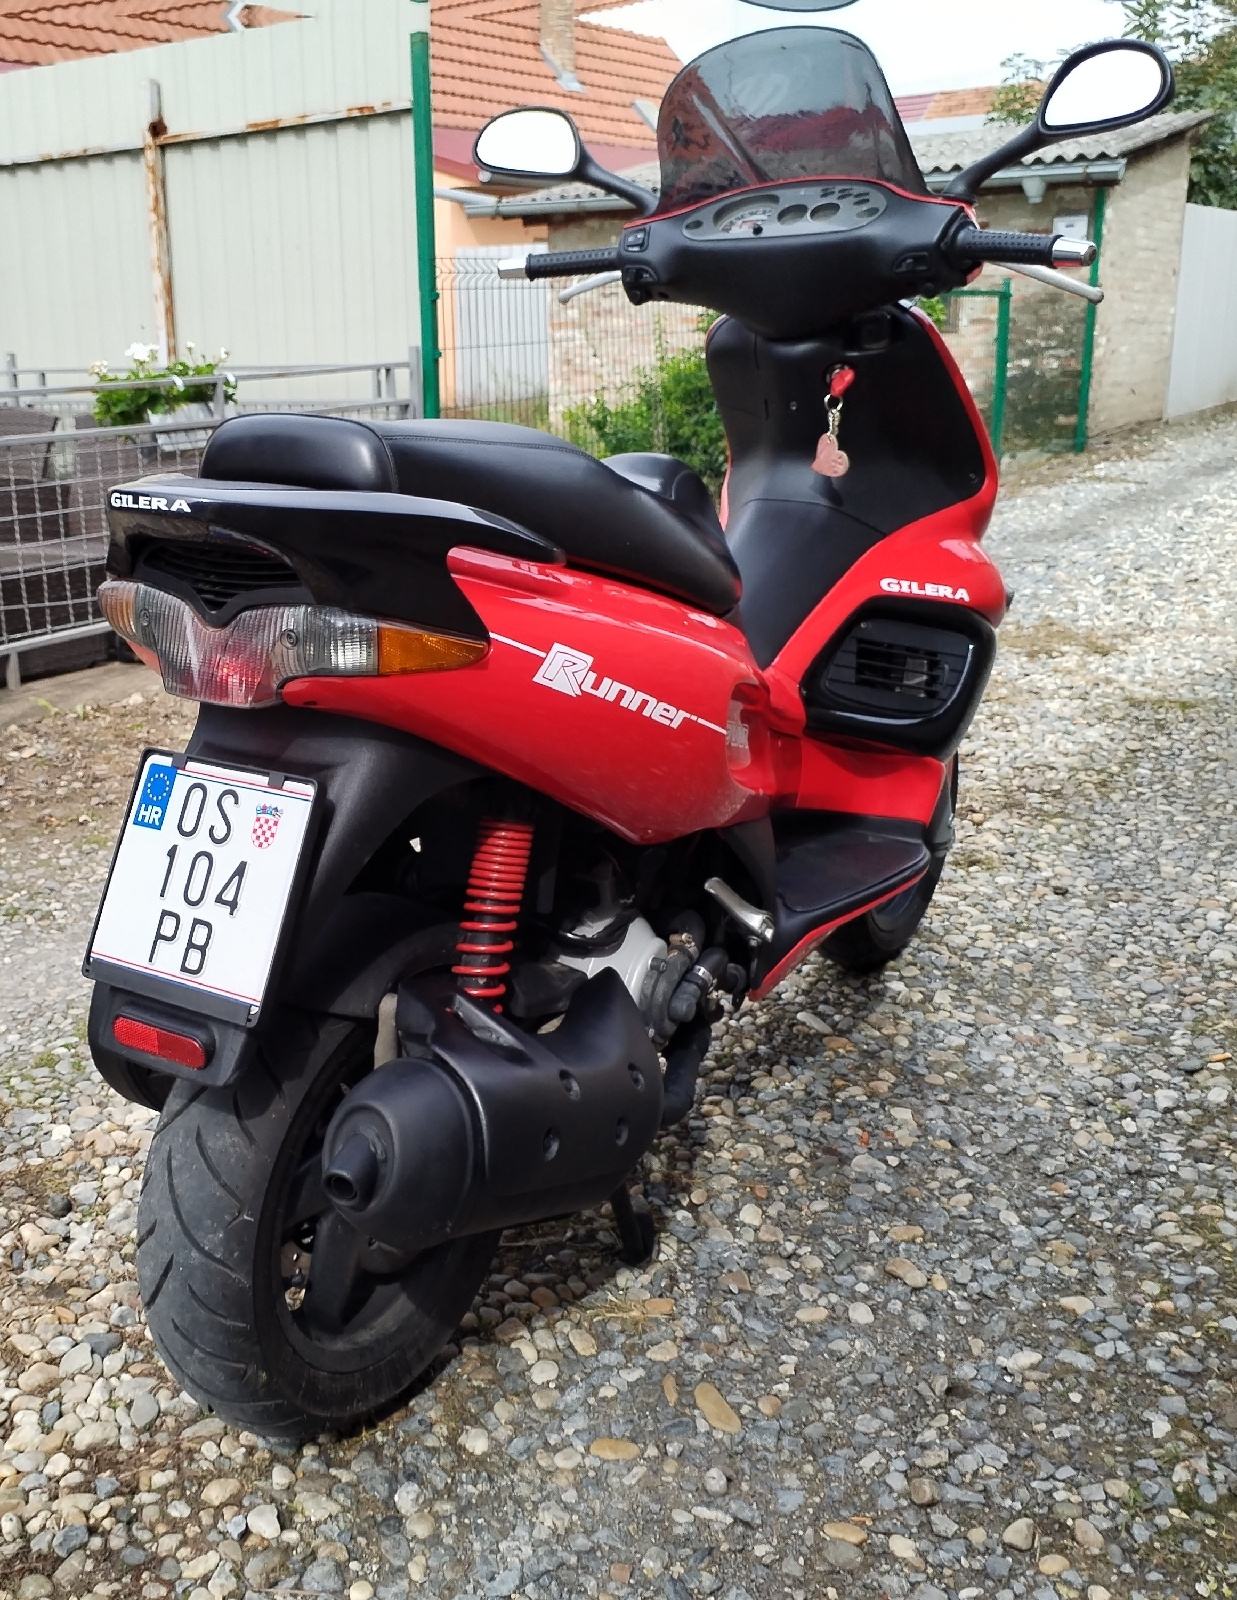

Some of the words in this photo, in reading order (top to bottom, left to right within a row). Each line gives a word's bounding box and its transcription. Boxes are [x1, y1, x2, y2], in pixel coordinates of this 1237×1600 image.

[110, 492, 192, 513] GILERA
[880, 577, 970, 603] GILERA
[532, 642, 692, 729] Runner
[138, 804, 163, 827] HR
[177, 782, 240, 845] OS
[159, 844, 248, 916] 104
[148, 909, 213, 975] PB
